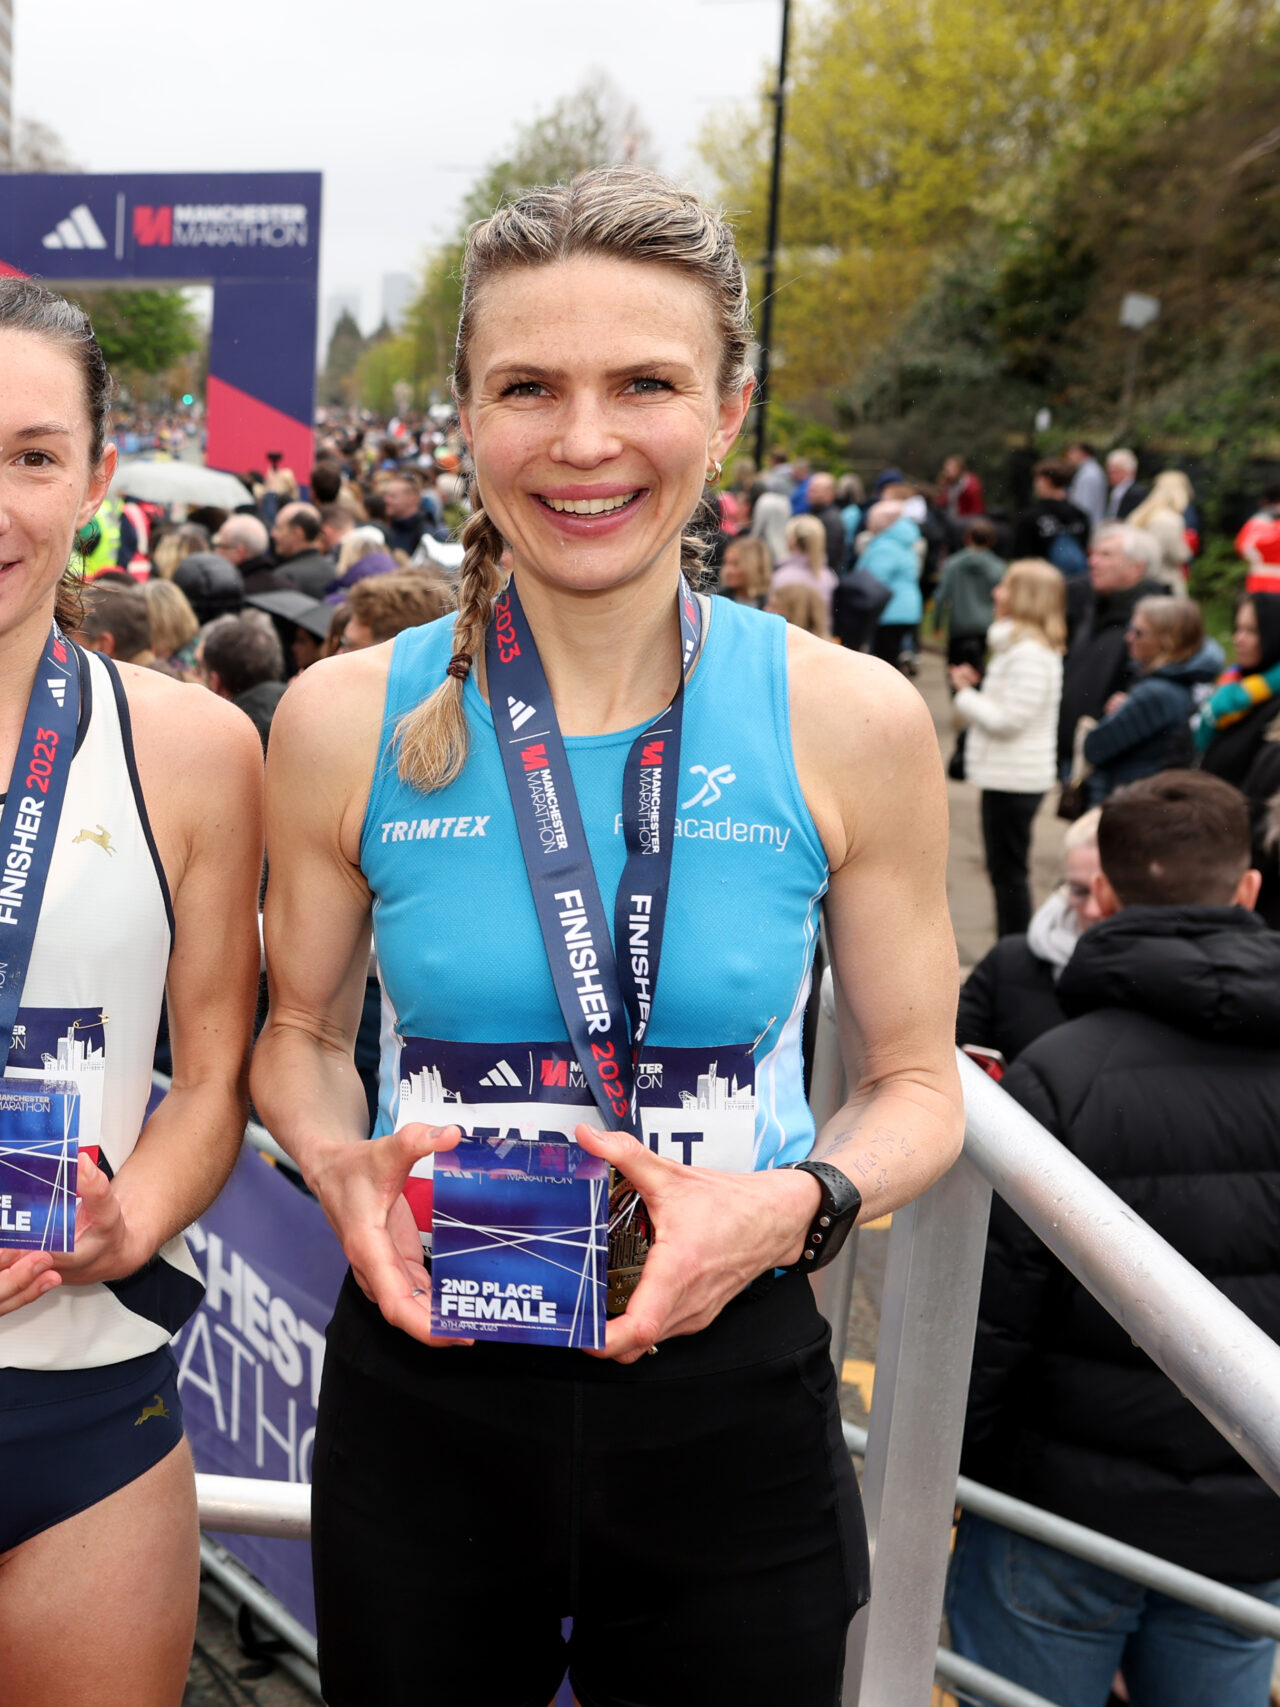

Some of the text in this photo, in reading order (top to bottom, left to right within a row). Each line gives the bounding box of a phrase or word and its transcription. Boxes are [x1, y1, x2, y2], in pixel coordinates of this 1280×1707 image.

[173, 223, 308, 247] MARATHON
[174, 203, 308, 224] MANCHESTER
[495, 596, 521, 664] 2023
[26, 727, 60, 794] 2023
[381, 815, 491, 843] TRIMTEX
[526, 770, 558, 854] MARATHON
[540, 768, 568, 851] MANCHESTER
[639, 768, 653, 855] MARATHON
[650, 767, 662, 854] MANCHESTER
[629, 894, 652, 1042] FINISHER
[554, 889, 612, 1036] FINISHER
[590, 1041, 629, 1118] 2023
[440, 1294, 557, 1324] FEMALE
[441, 1278, 544, 1300] 2ND PLACE
